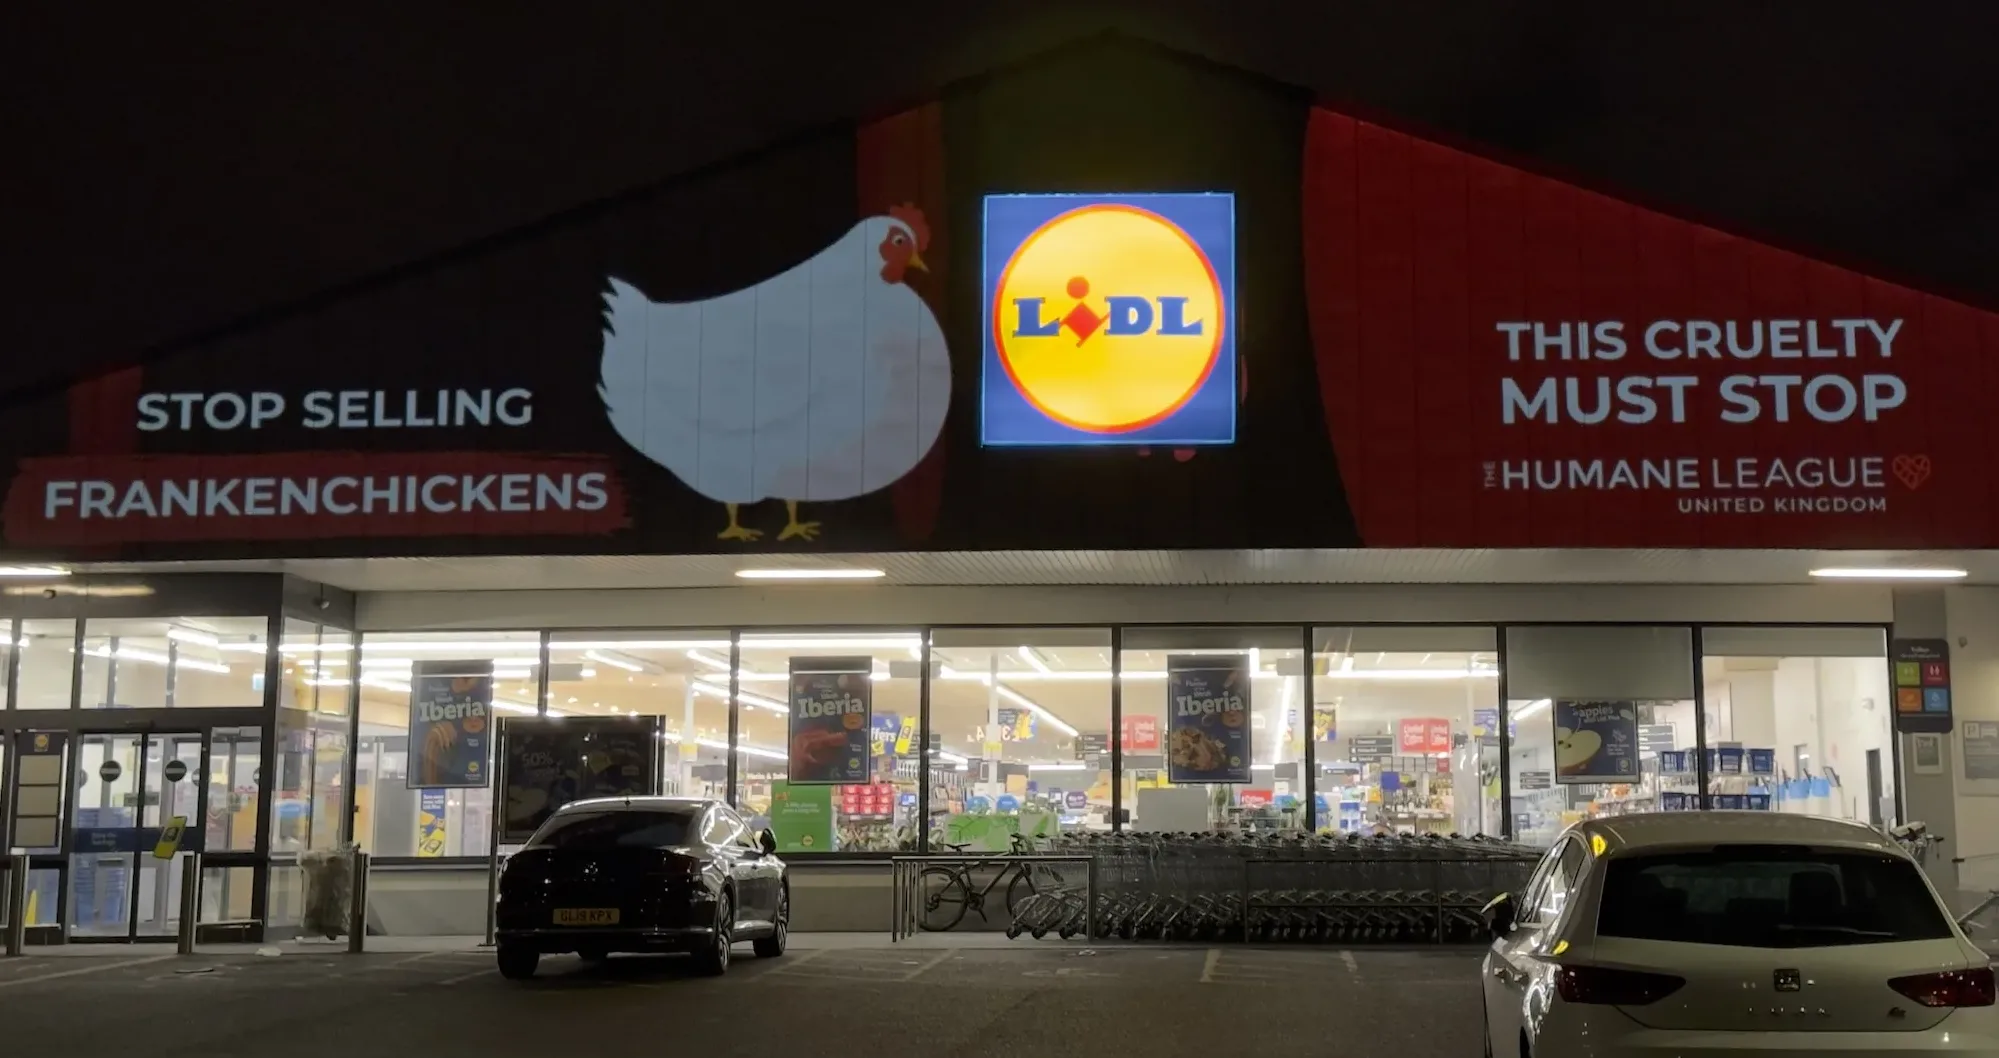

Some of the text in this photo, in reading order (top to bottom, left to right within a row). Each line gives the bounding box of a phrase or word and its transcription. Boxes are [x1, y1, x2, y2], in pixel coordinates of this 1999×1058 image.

[1496, 318, 1905, 362] THIS CRUELTY
[137, 388, 533, 432] STOP SELLING
[1502, 374, 1908, 426] MUST STOP
[1483, 461, 1496, 488] THE
[1502, 457, 1886, 491] HUMANE LEAGUE
[44, 472, 609, 520] FRANKENCHICKENS
[1678, 497, 1888, 515] UNITED KINGDOM
[419, 696, 486, 722] Iberia
[798, 693, 864, 718] Iberia
[1176, 691, 1244, 717] Iberia
[871, 728, 896, 742] ffers
